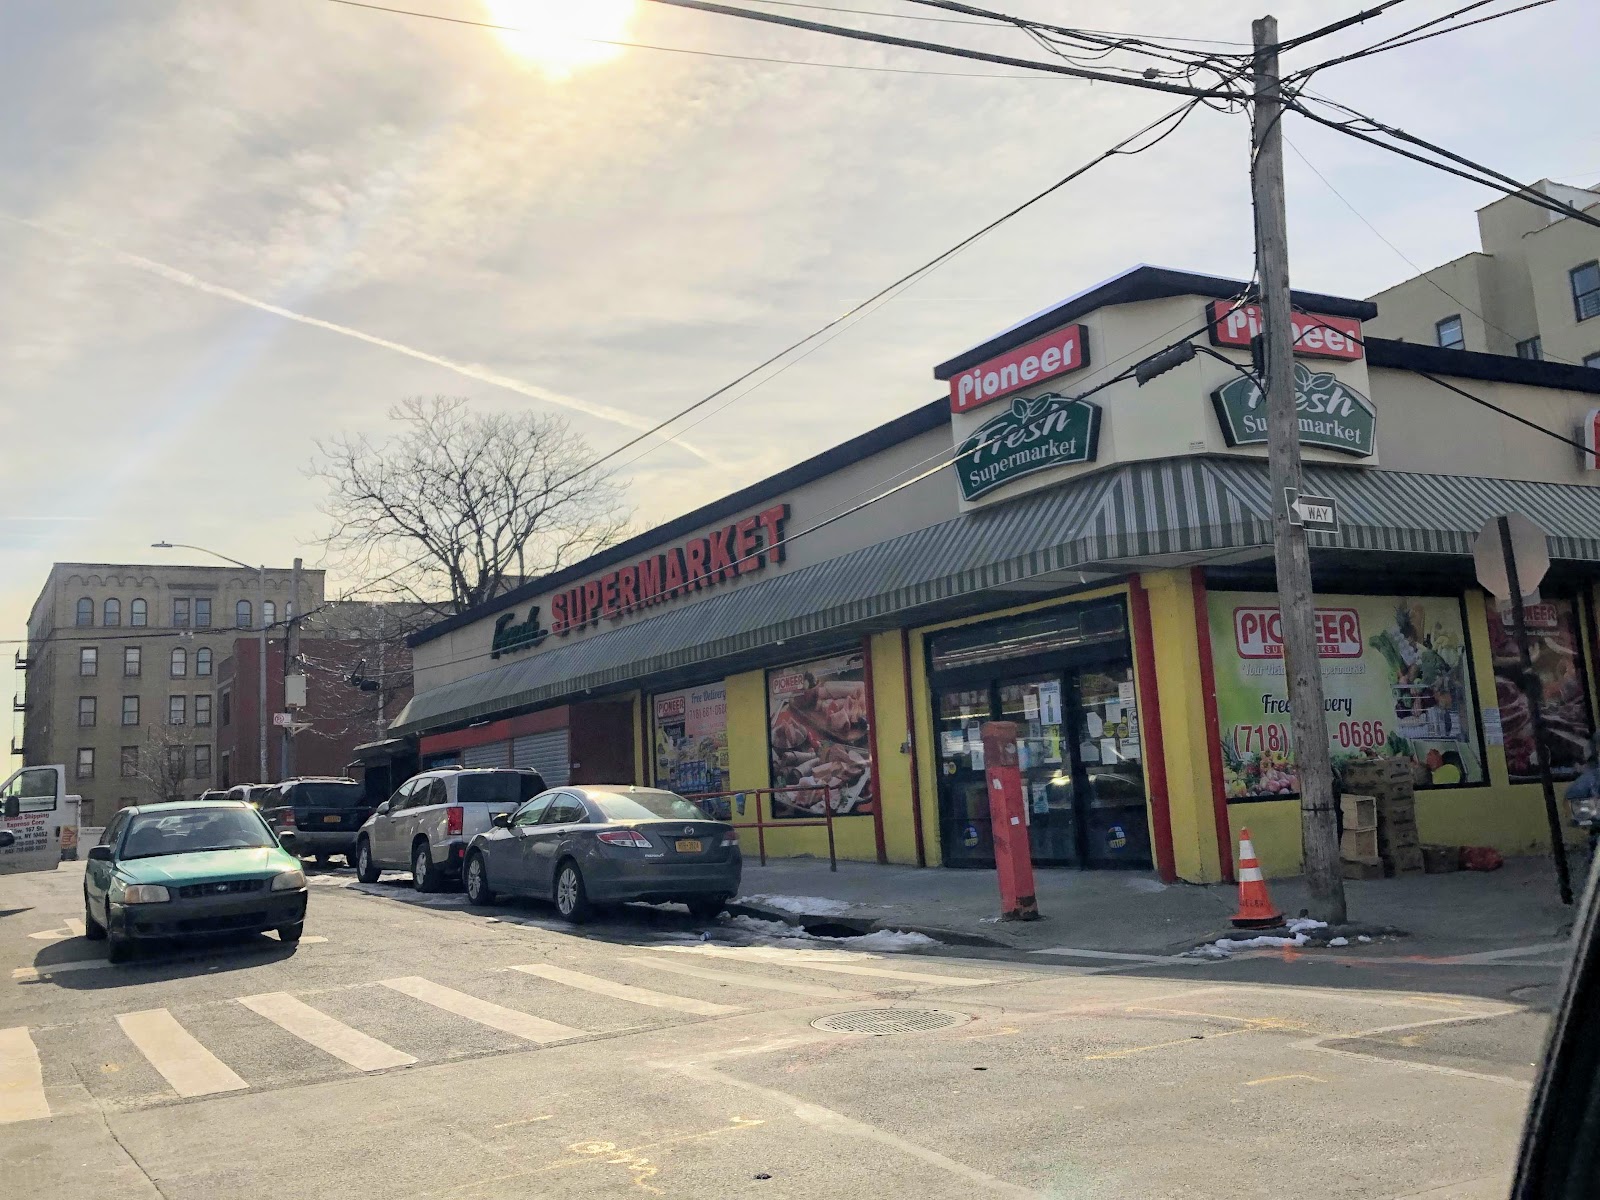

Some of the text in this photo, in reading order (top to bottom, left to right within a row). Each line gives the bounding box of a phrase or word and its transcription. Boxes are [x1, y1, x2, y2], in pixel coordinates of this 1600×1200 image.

[1226, 306, 1356, 353] Pineer
[957, 338, 1074, 406] Pioneer
[1247, 377, 1355, 418] Fesh
[973, 404, 1071, 464] Fresh
[1243, 413, 1362, 445] Sumarket
[969, 436, 1077, 488] Supermarket
[1307, 506, 1328, 521] WAY
[551, 503, 788, 637] SUPERMARKET
[1240, 612, 1359, 644] PIOEER
[773, 675, 804, 692] PIONEER
[658, 699, 685, 714] PIONEER
[1233, 723, 1289, 760] (718)
